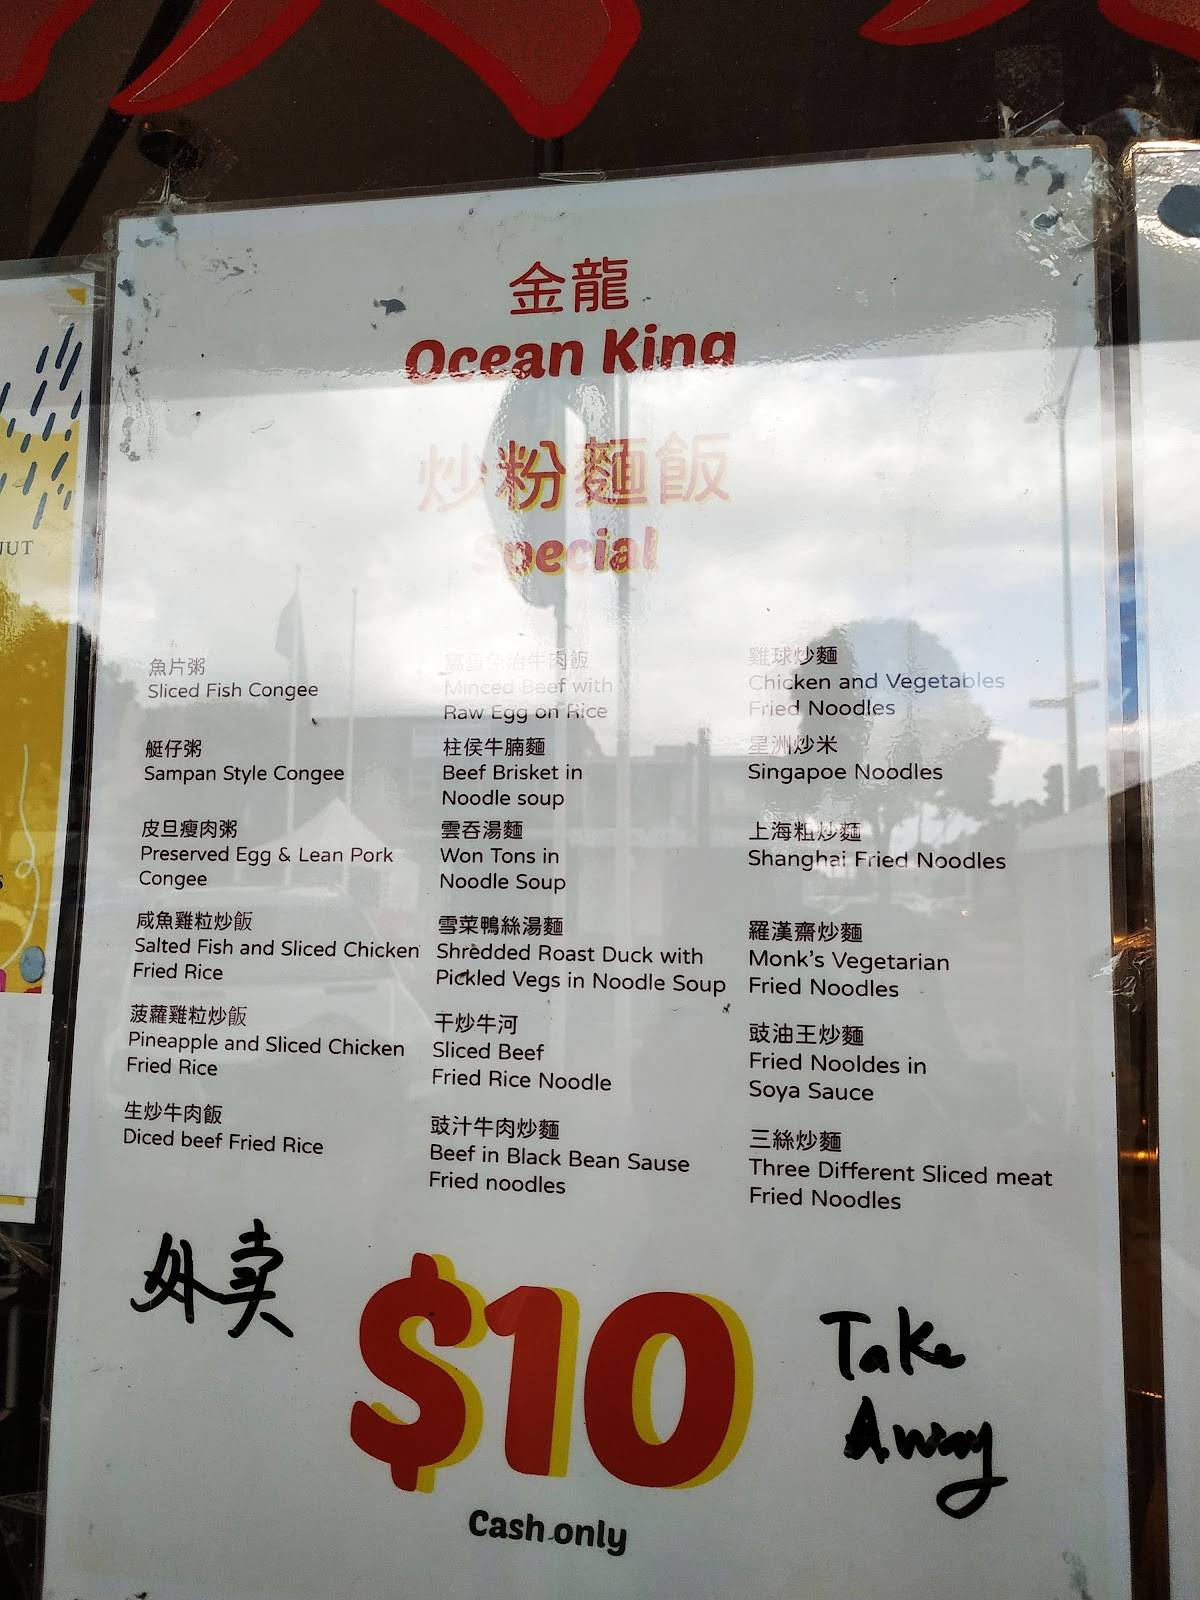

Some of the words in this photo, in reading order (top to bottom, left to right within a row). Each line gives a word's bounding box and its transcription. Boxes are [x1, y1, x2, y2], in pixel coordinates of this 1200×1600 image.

[509, 256, 629, 315] 金龍
[404, 338, 584, 385] Ocean
[417, 432, 734, 512] 炒粉麵飯
[471, 526, 661, 579] Special
[149, 657, 206, 677] 魚片粥
[748, 645, 838, 667] 雞球炒麵
[148, 682, 200, 699] Sliced
[206, 682, 242, 698] Fish
[248, 682, 319, 701] Congee
[444, 679, 514, 696] Minced
[522, 677, 567, 694] Beef
[572, 677, 614, 693] with
[748, 673, 831, 691] Chicken
[839, 673, 878, 690] and
[885, 672, 1005, 694] Vegetables
[444, 705, 484, 720] Raw
[491, 705, 528, 724] Egg
[535, 706, 559, 720] on
[567, 703, 608, 719] Rice
[749, 699, 800, 717] Fried
[808, 699, 896, 717] Noodles
[145, 739, 202, 758] 艇仔粥
[443, 737, 545, 757] 柱侯牛腩麵
[749, 734, 838, 755] 星洲炒米
[144, 766, 217, 785] Sampan
[223, 764, 268, 785] Style
[273, 766, 345, 785] Congee
[442, 764, 486, 781] Beef
[492, 764, 559, 781] Brisket
[566, 764, 583, 781] in
[748, 763, 847, 785] Singapoe
[854, 763, 944, 781] Noodles
[442, 789, 511, 806] Noodle
[517, 792, 564, 810] soup
[141, 819, 238, 839] 皮旦瘦肉粥
[441, 820, 523, 840] 雲吞湯麵
[748, 821, 863, 842] 上海粗炒麵
[140, 845, 229, 862] Preserved
[236, 847, 271, 866] Egg
[278, 847, 291, 862] &
[299, 847, 344, 863] Lean
[350, 846, 393, 863] Pork
[440, 848, 483, 864] Won
[490, 848, 536, 865] Tons
[542, 848, 559, 864] in
[748, 850, 847, 872] Shanghai
[855, 851, 908, 869] Fried
[916, 852, 1007, 870] Noodles
[139, 870, 208, 890] Congee
[440, 873, 509, 889] Noodle
[516, 874, 567, 894] Soup
[136, 910, 253, 932] 咸魚雞粒炒飯
[438, 915, 564, 938] 雪菜鴨絲湯麵
[748, 920, 863, 943] 羅漢齋炒麵
[134, 937, 191, 954] Salted
[198, 938, 233, 955] Fish
[239, 940, 274, 956] and
[281, 940, 337, 958] Sliced
[343, 941, 420, 959] Chicken
[436, 943, 531, 962] Shredded
[538, 945, 595, 963] Roast
[602, 946, 653, 964] Duck
[660, 948, 703, 966] with
[133, 962, 178, 979] Fried
[184, 964, 224, 980] Rice
[832, 951, 950, 974] Vegetarian
[436, 969, 505, 988] Pickled
[512, 971, 561, 993] Vegs
[568, 973, 585, 989] in
[593, 972, 665, 992] Noodle
[672, 975, 726, 997] Soup
[749, 977, 801, 995] Fried
[810, 979, 899, 998] Noodles
[130, 1004, 247, 1027] 菠蘿雞粒炒飯
[434, 1013, 518, 1035] 干炒牛河
[128, 1032, 219, 1054] Pineapple
[224, 1035, 259, 1052] and
[266, 1036, 321, 1054] Sliced
[328, 1038, 405, 1057] Chicken
[749, 1022, 864, 1047] 豉油王炒麵
[432, 1042, 491, 1060] Sliced
[498, 1043, 545, 1061] Beef
[127, 1057, 172, 1074] Fried
[179, 1059, 218, 1076] Rice
[749, 1052, 802, 1070] Fried
[811, 1054, 900, 1074] Nooldes
[907, 1056, 927, 1075] in
[432, 1069, 481, 1087] Fried
[489, 1071, 531, 1089] Rice
[538, 1072, 612, 1091] Noodle
[749, 1080, 801, 1103] Soya
[808, 1082, 874, 1101] Sauce
[124, 1101, 223, 1125] 生炒牛肉飯
[430, 1115, 560, 1141] 豉汁牛肉炒麵
[123, 1128, 174, 1146] Diced
[181, 1130, 223, 1149] beef
[229, 1133, 275, 1151] Fried
[283, 1136, 324, 1155] Rice
[750, 1128, 842, 1152] 三絲炒麵
[430, 1144, 476, 1162] Beef
[482, 1146, 499, 1164] in
[507, 1147, 561, 1166] Black
[568, 1150, 620, 1169] Bean
[627, 1153, 690, 1173] Sause
[429, 1171, 478, 1190] Fried
[485, 1174, 566, 1195] noodles
[749, 1158, 810, 1178] Three
[818, 1161, 915, 1182] Different
[922, 1164, 988, 1185] Sliced
[996, 1168, 1053, 1187] meat
[749, 1186, 803, 1206] Fried
[811, 1189, 901, 1210] Noodles
[130, 1218, 294, 1339] 外卖
[819, 1305, 966, 1381] Take
[350, 1252, 754, 1494] $10
[843, 1395, 1009, 1519] Away
[468, 1509, 545, 1543] Cash
[554, 1515, 628, 1557] only
